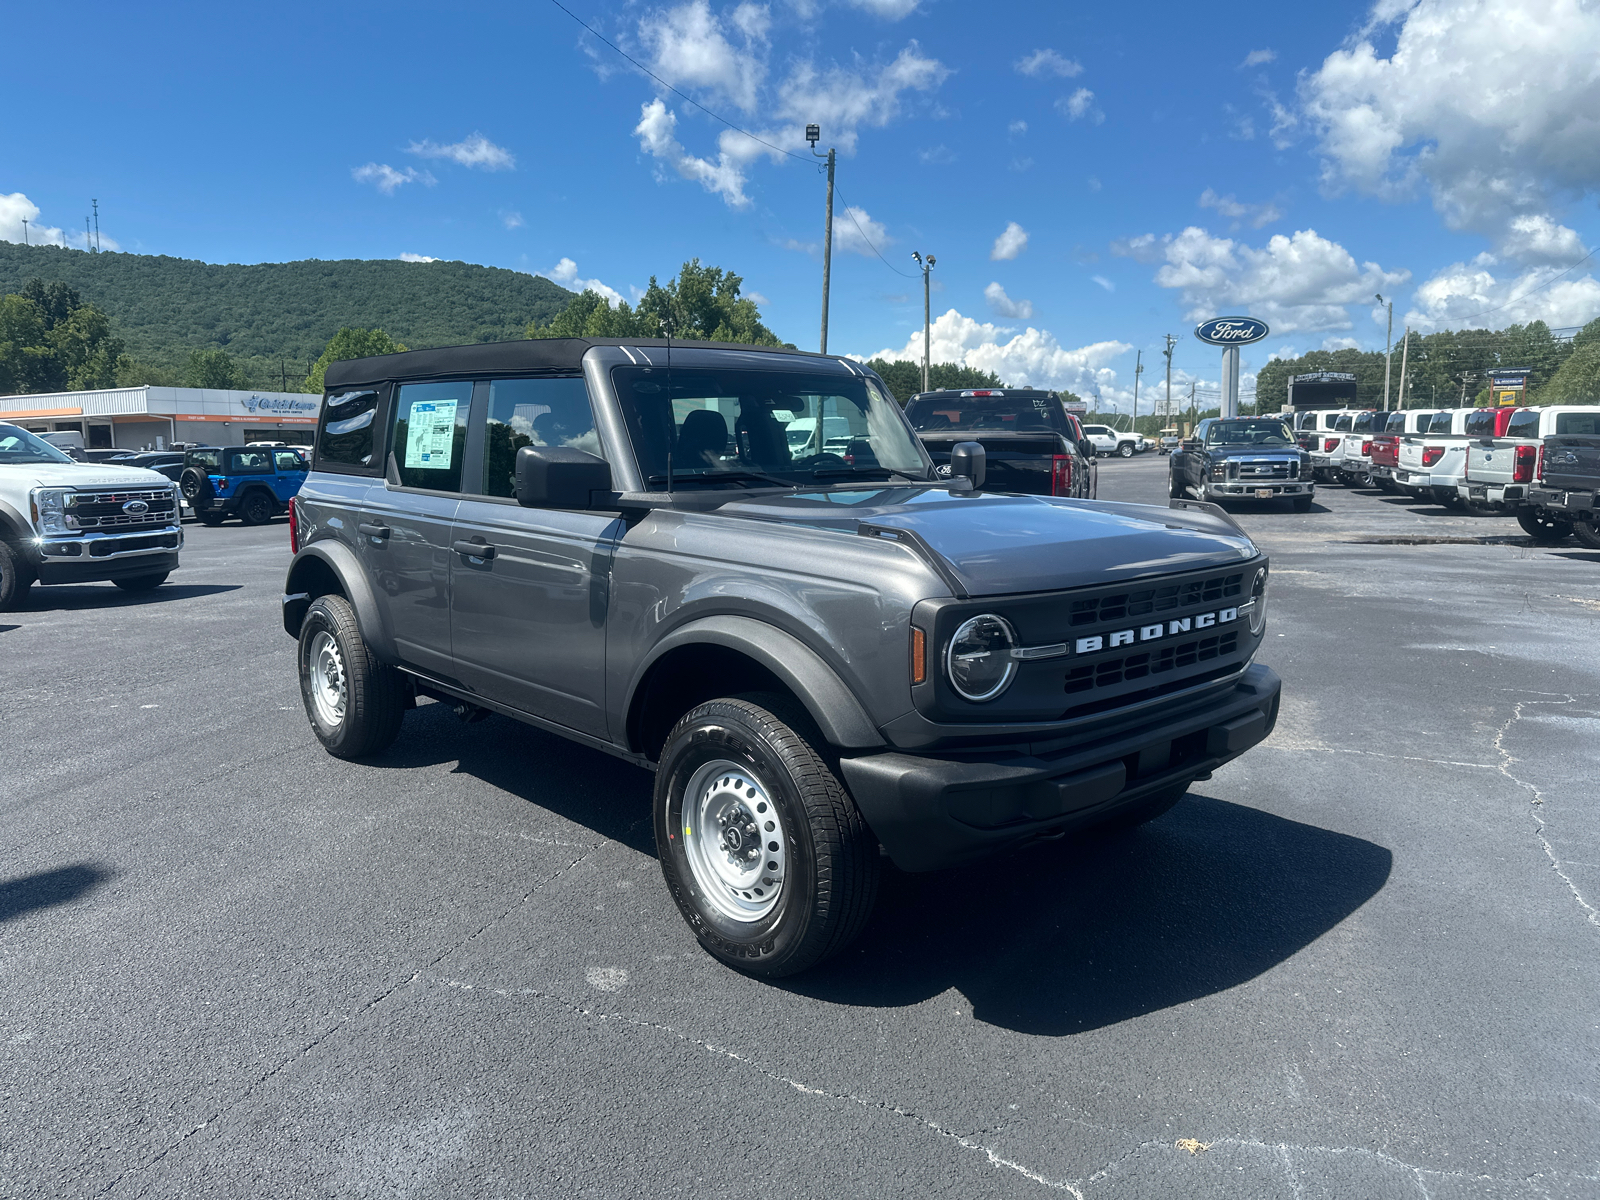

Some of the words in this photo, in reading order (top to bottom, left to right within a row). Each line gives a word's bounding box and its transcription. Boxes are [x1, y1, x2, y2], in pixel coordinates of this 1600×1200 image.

[1211, 322, 1255, 339] Ford
[259, 398, 289, 409] Quick
[290, 400, 316, 410] Lane
[1075, 607, 1238, 654] BRONCO
